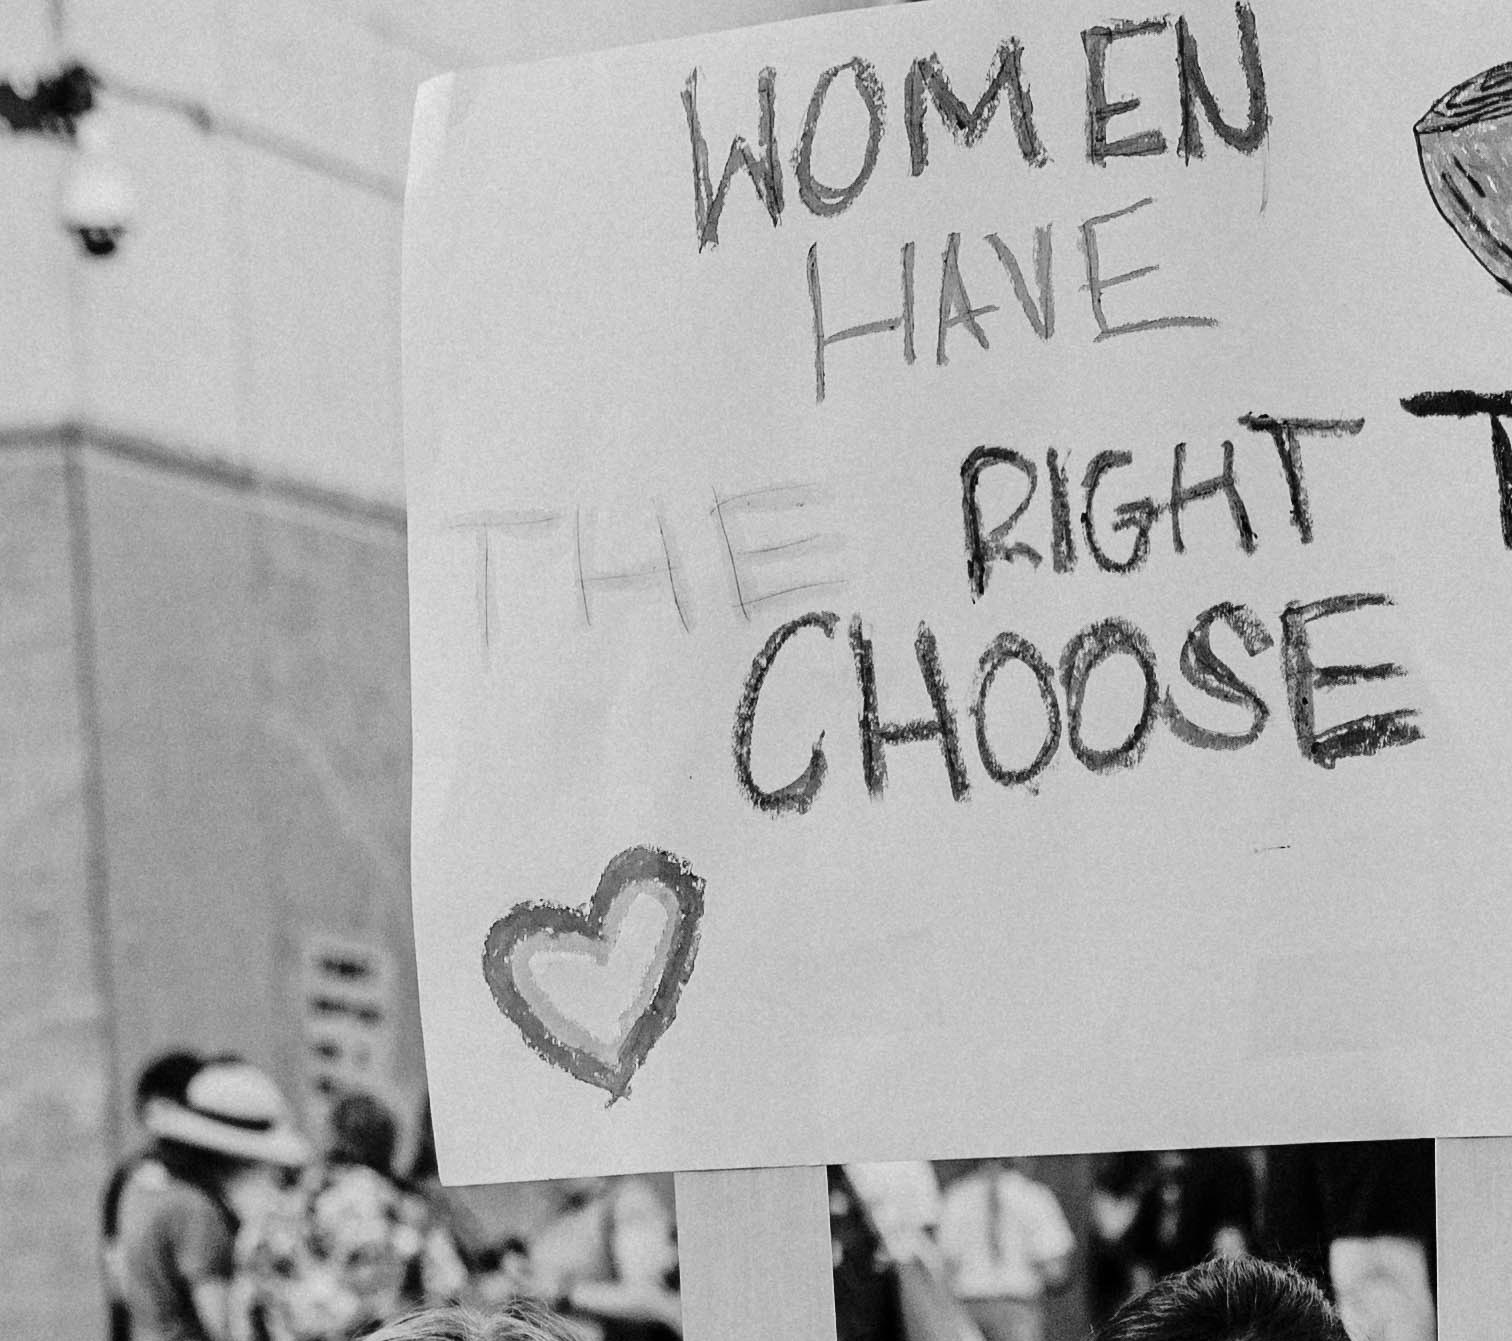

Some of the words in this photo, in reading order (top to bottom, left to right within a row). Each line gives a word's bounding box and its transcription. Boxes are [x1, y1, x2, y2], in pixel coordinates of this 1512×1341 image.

[682, 2, 1272, 252] WOMEN
[807, 197, 1219, 401] HAVE
[443, 483, 848, 645] THE
[961, 412, 1366, 602] RIGHT
[733, 594, 1428, 813] CHOOSE
